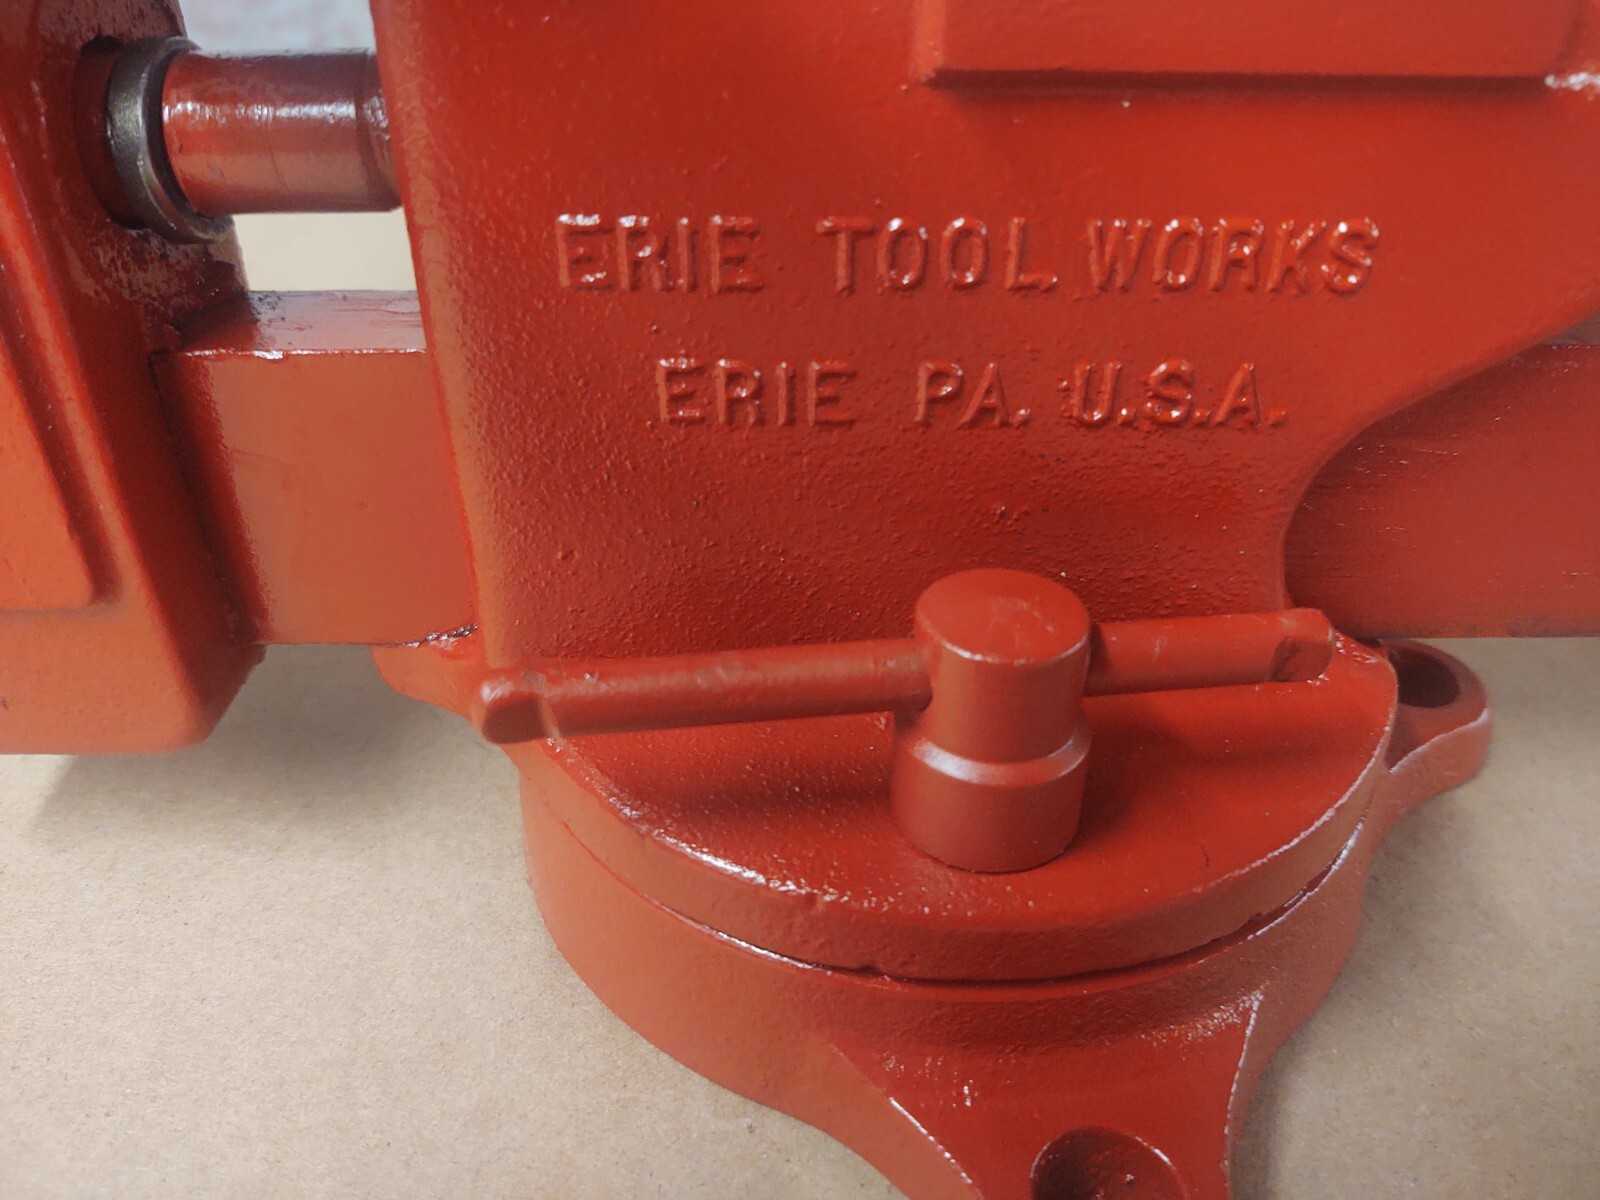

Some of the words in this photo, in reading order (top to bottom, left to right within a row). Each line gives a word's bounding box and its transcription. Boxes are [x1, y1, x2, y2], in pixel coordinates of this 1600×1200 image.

[556, 213, 760, 292] ERIE
[816, 214, 1058, 292] TOOL
[1087, 216, 1380, 294] WORKS
[656, 357, 856, 427] ERIE
[914, 361, 1032, 429] PA.
